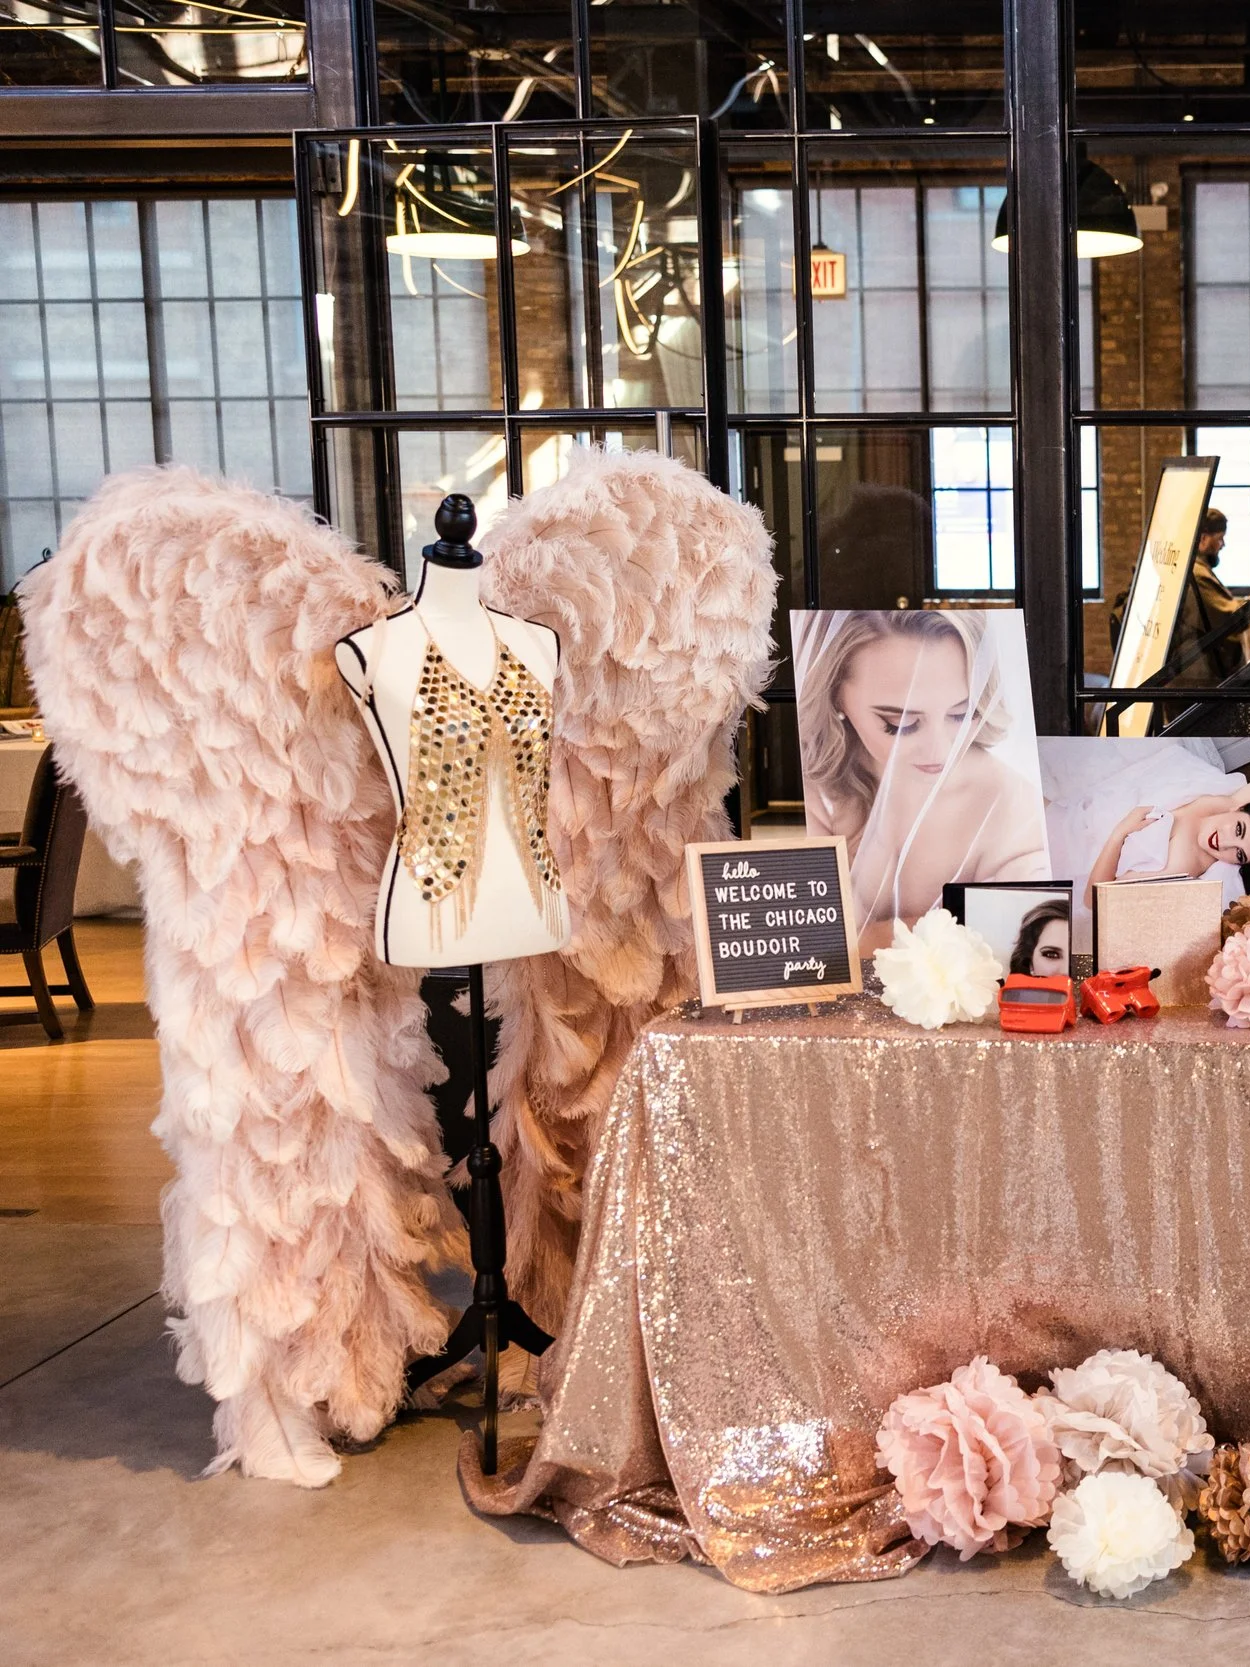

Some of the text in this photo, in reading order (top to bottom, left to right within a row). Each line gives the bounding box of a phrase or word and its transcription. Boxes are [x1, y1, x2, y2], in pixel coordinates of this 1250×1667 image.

[811, 260, 837, 289] XIT
[721, 861, 760, 881] hello
[715, 880, 828, 903] WELCOME TO
[718, 907, 838, 931] THE CHICAGO
[718, 936, 801, 959] BOUDOIR
[783, 956, 827, 981] party
